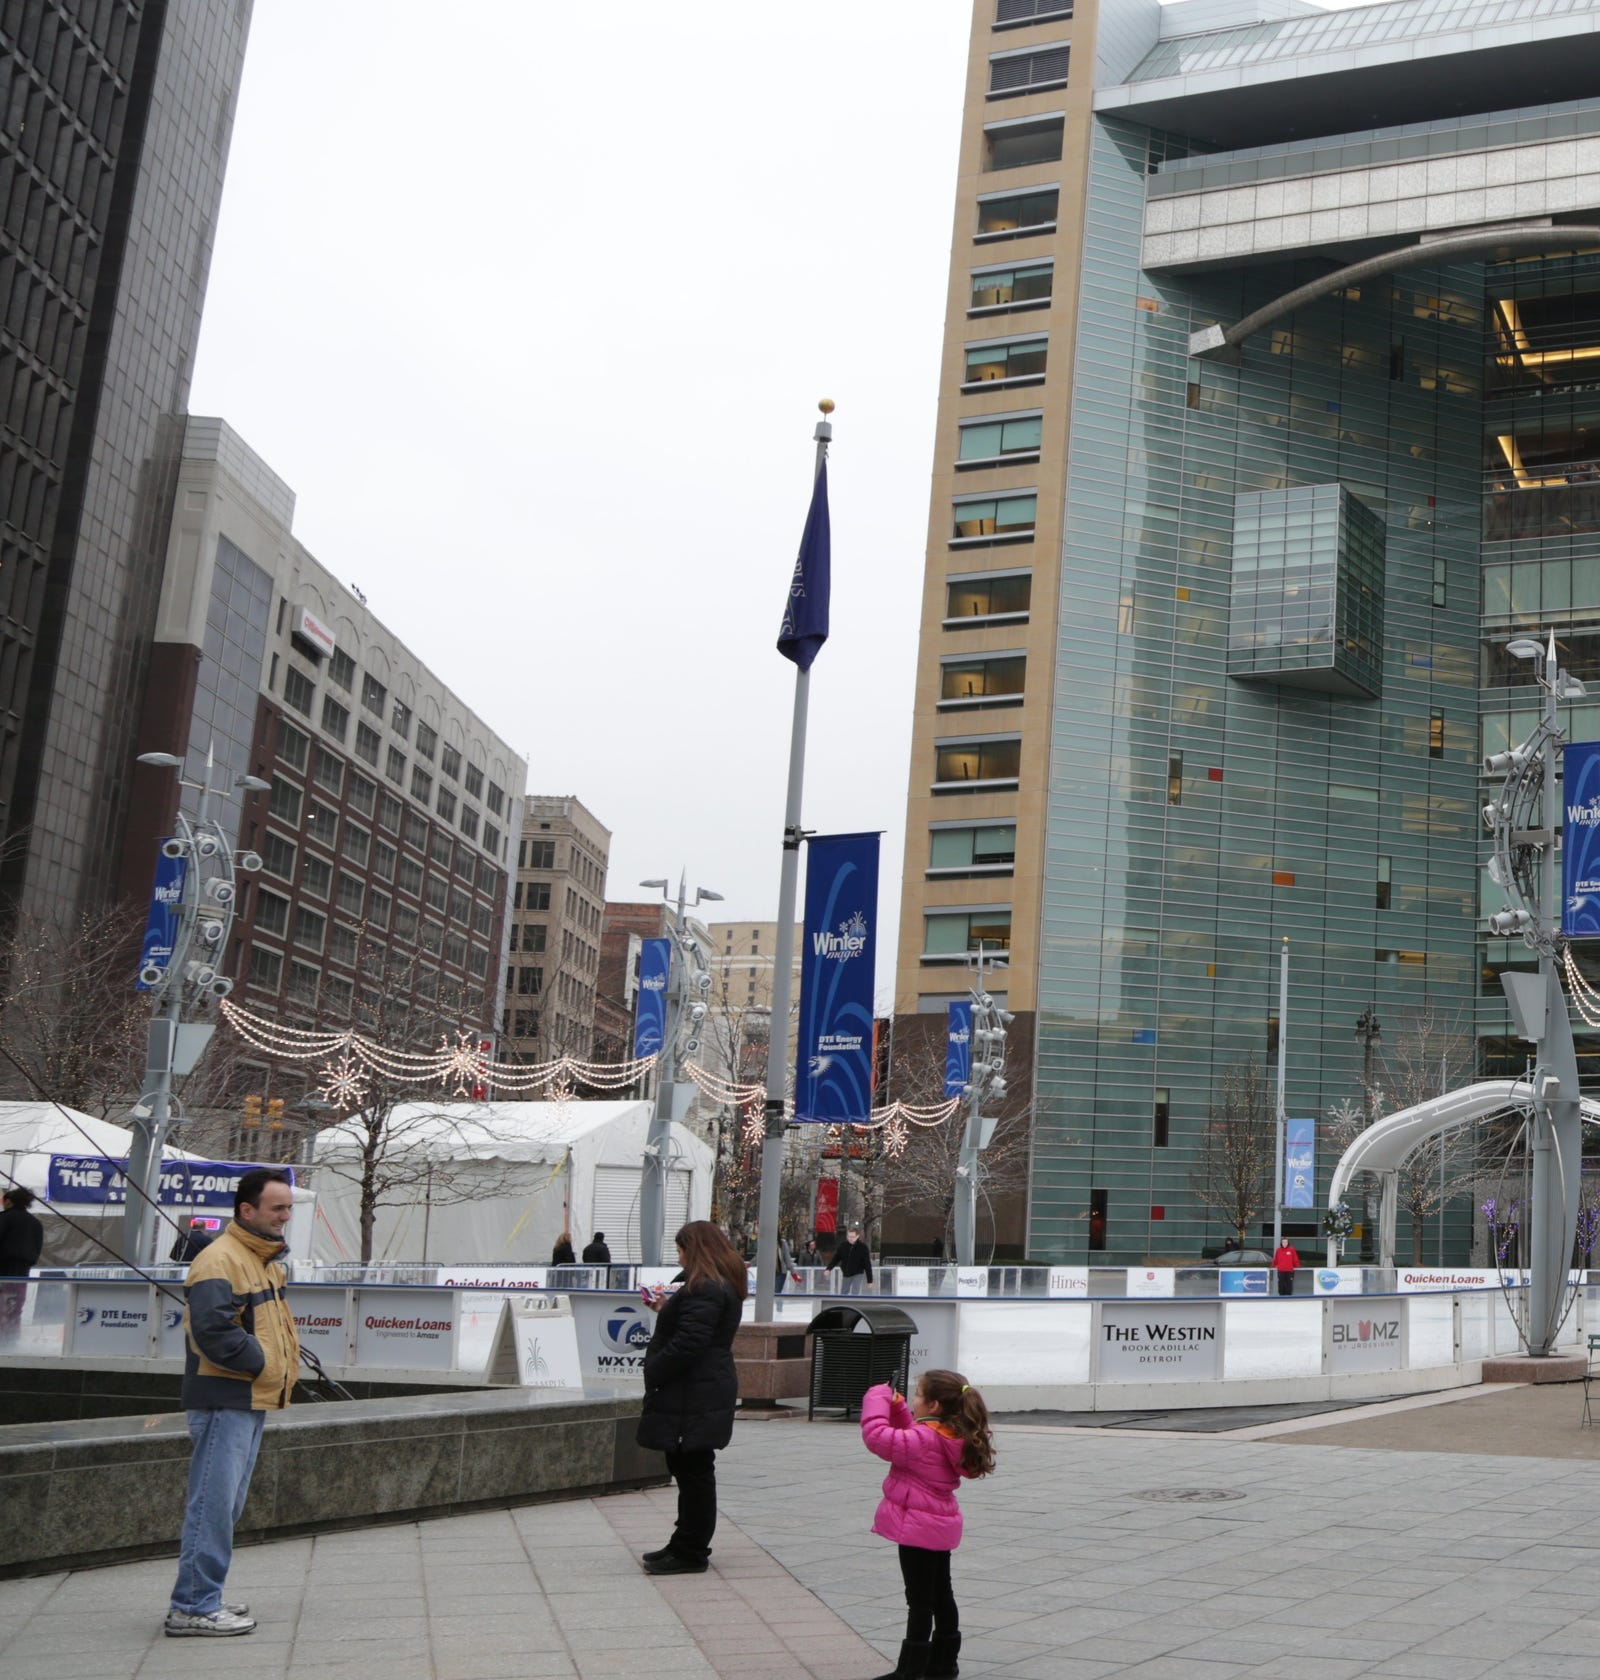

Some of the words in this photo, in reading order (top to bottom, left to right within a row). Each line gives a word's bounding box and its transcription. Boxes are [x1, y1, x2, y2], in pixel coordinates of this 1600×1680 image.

[155, 887, 181, 900] Winter
[813, 932, 866, 956] Winter
[826, 949, 862, 963] magic
[818, 1035, 834, 1043] DTE
[835, 1035, 863, 1045] Energy
[818, 1042, 861, 1051] Foundation
[58, 1169, 104, 1188] THE
[108, 1172, 184, 1190] ATIC
[191, 1175, 240, 1192] ZONE
[1051, 1275, 1087, 1289] Hines
[1404, 1274, 1450, 1284] Quicken
[1451, 1274, 1485, 1284] Loans
[101, 1310, 119, 1319] DTE
[121, 1310, 148, 1321] Energ
[307, 1314, 343, 1327] Loans
[100, 1320, 138, 1328] Foundation
[365, 1315, 414, 1330] Quicken
[415, 1318, 453, 1331] Loans
[308, 1328, 330, 1336] Amaze
[376, 1330, 408, 1339] Engineered
[416, 1331, 440, 1340] Amaze
[629, 1331, 651, 1343] abc
[1122, 1344, 1150, 1352] BOOK
[1153, 1343, 1200, 1351] CADILLAC
[598, 1356, 646, 1367] WXYZ
[1139, 1355, 1183, 1363] DETROIT
